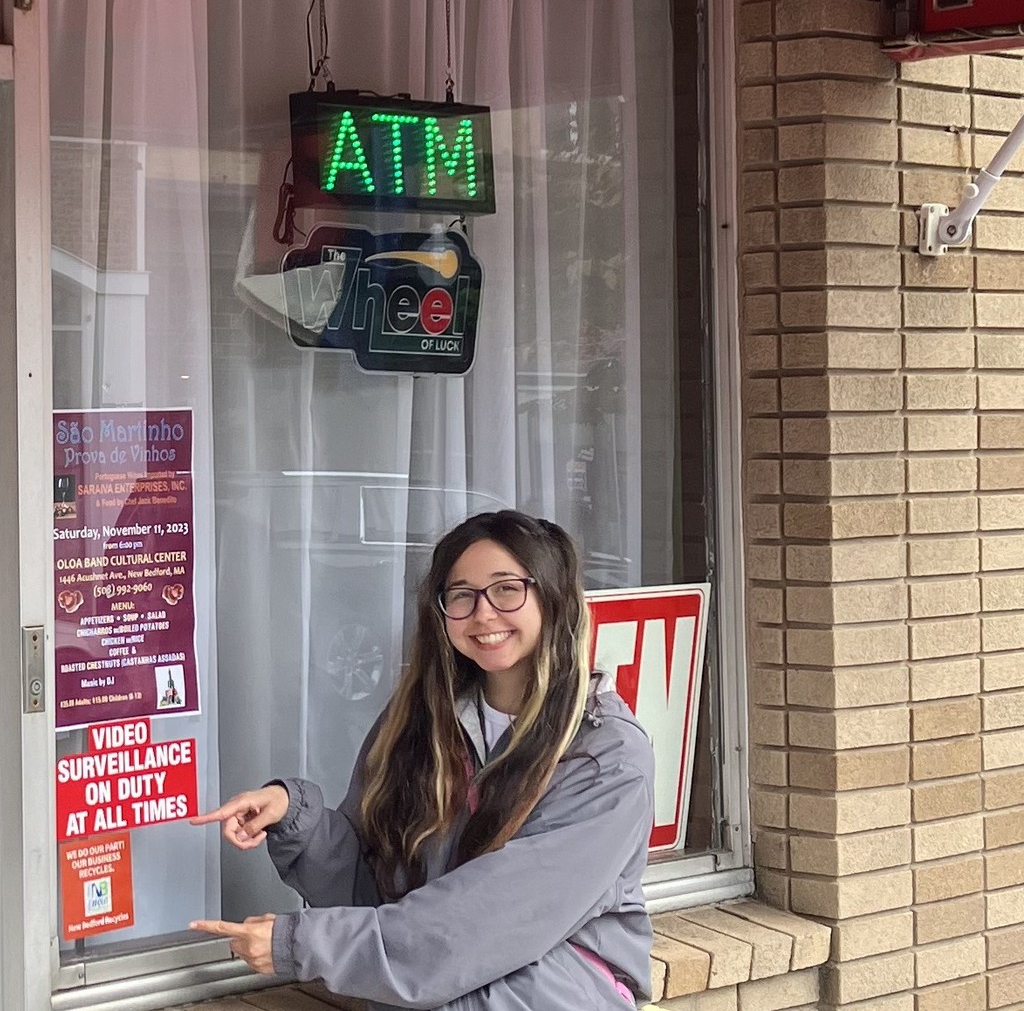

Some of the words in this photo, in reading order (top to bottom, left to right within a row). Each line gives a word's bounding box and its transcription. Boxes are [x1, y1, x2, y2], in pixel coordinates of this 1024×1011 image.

[322, 111, 476, 196] ATM
[327, 248, 346, 262] The
[297, 247, 471, 335] Wheel
[421, 340, 434, 350] OF
[435, 340, 460, 351] LUCK
[100, 418, 184, 443] Martinho
[64, 447, 106, 468] Prova
[110, 447, 126, 463] de
[130, 445, 176, 462] Vinhos
[171, 480, 187, 491] INC.
[53, 526, 101, 540] Saturday,
[103, 523, 151, 537] November
[154, 524, 164, 536] 11,
[166, 523, 189, 535] 2023
[103, 541, 118, 550] from
[57, 558, 83, 570] OLOA
[85, 556, 109, 568] BAND
[110, 554, 153, 566] CULTURAL
[154, 551, 187, 563] CENTER
[59, 575, 76, 585] 1446
[77, 572, 108, 583] Acushnet
[128, 569, 143, 578] New
[144, 567, 172, 578] Bedford,
[173, 566, 185, 575] MA
[93, 584, 115, 598] (508)
[116, 582, 153, 596] 992-9060
[111, 601, 135, 611] MENU:
[109, 647, 129, 657] COFFEE
[92, 721, 148, 750] VIDEO
[57, 741, 192, 783] SURVEILLANCE
[85, 780, 111, 806] ON
[118, 772, 166, 801] DUTY
[65, 812, 88, 837] AT
[93, 805, 128, 832] ALL
[132, 794, 188, 825] TIMES
[66, 850, 77, 860] WE
[77, 847, 89, 858] DO
[89, 845, 105, 856] OUR
[71, 858, 87, 869] OUR
[87, 852, 122, 867] BUSINESS
